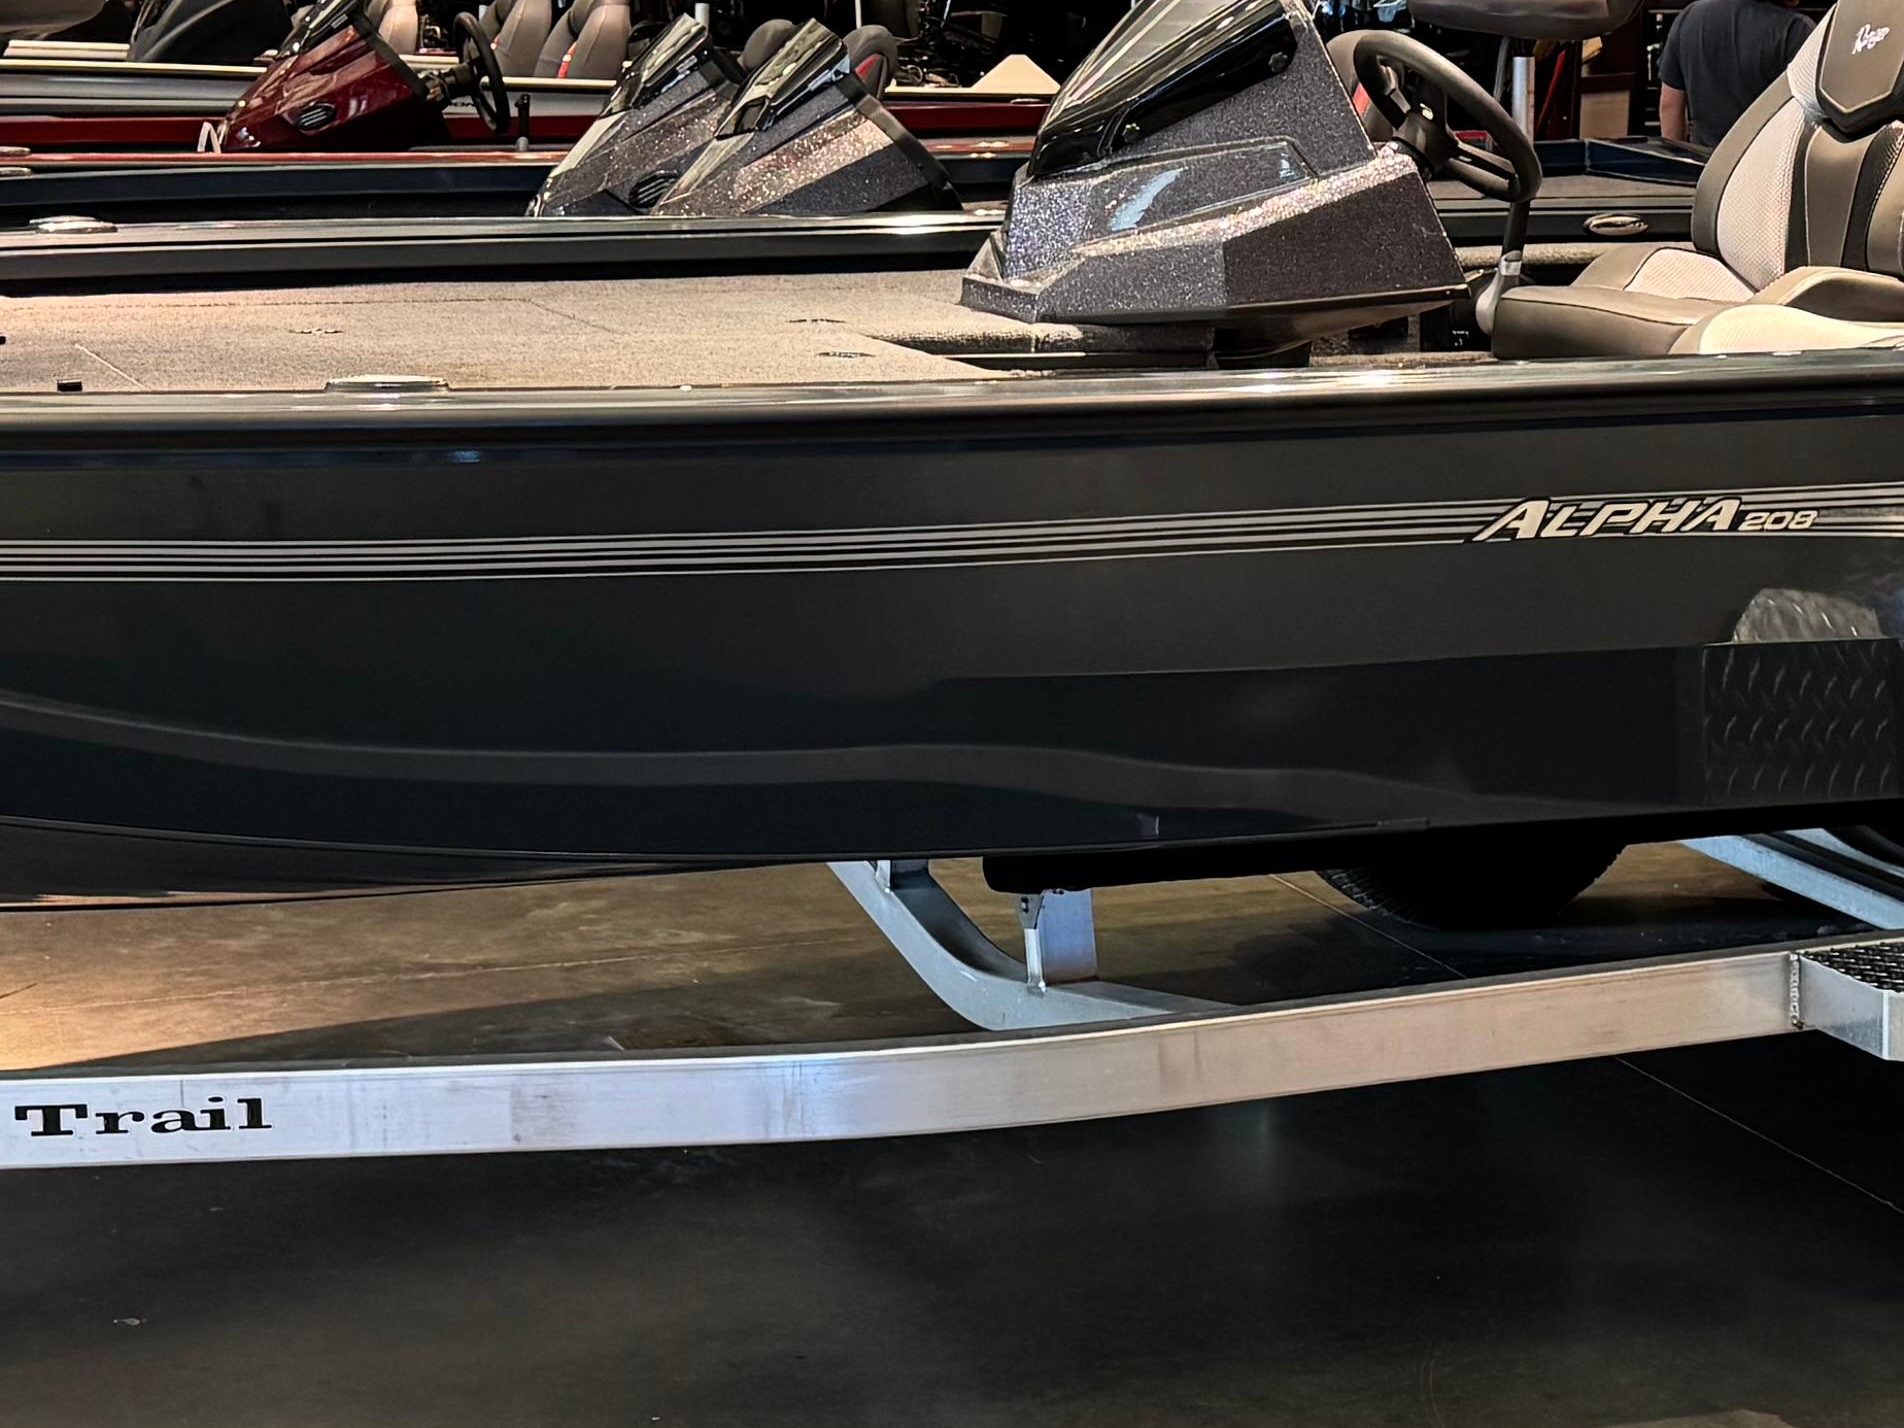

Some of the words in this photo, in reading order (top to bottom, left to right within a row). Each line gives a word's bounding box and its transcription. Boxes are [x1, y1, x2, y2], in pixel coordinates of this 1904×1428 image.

[1476, 497, 1744, 541] ALPHA
[1738, 509, 1820, 532] 208
[13, 1094, 273, 1138] Trail
